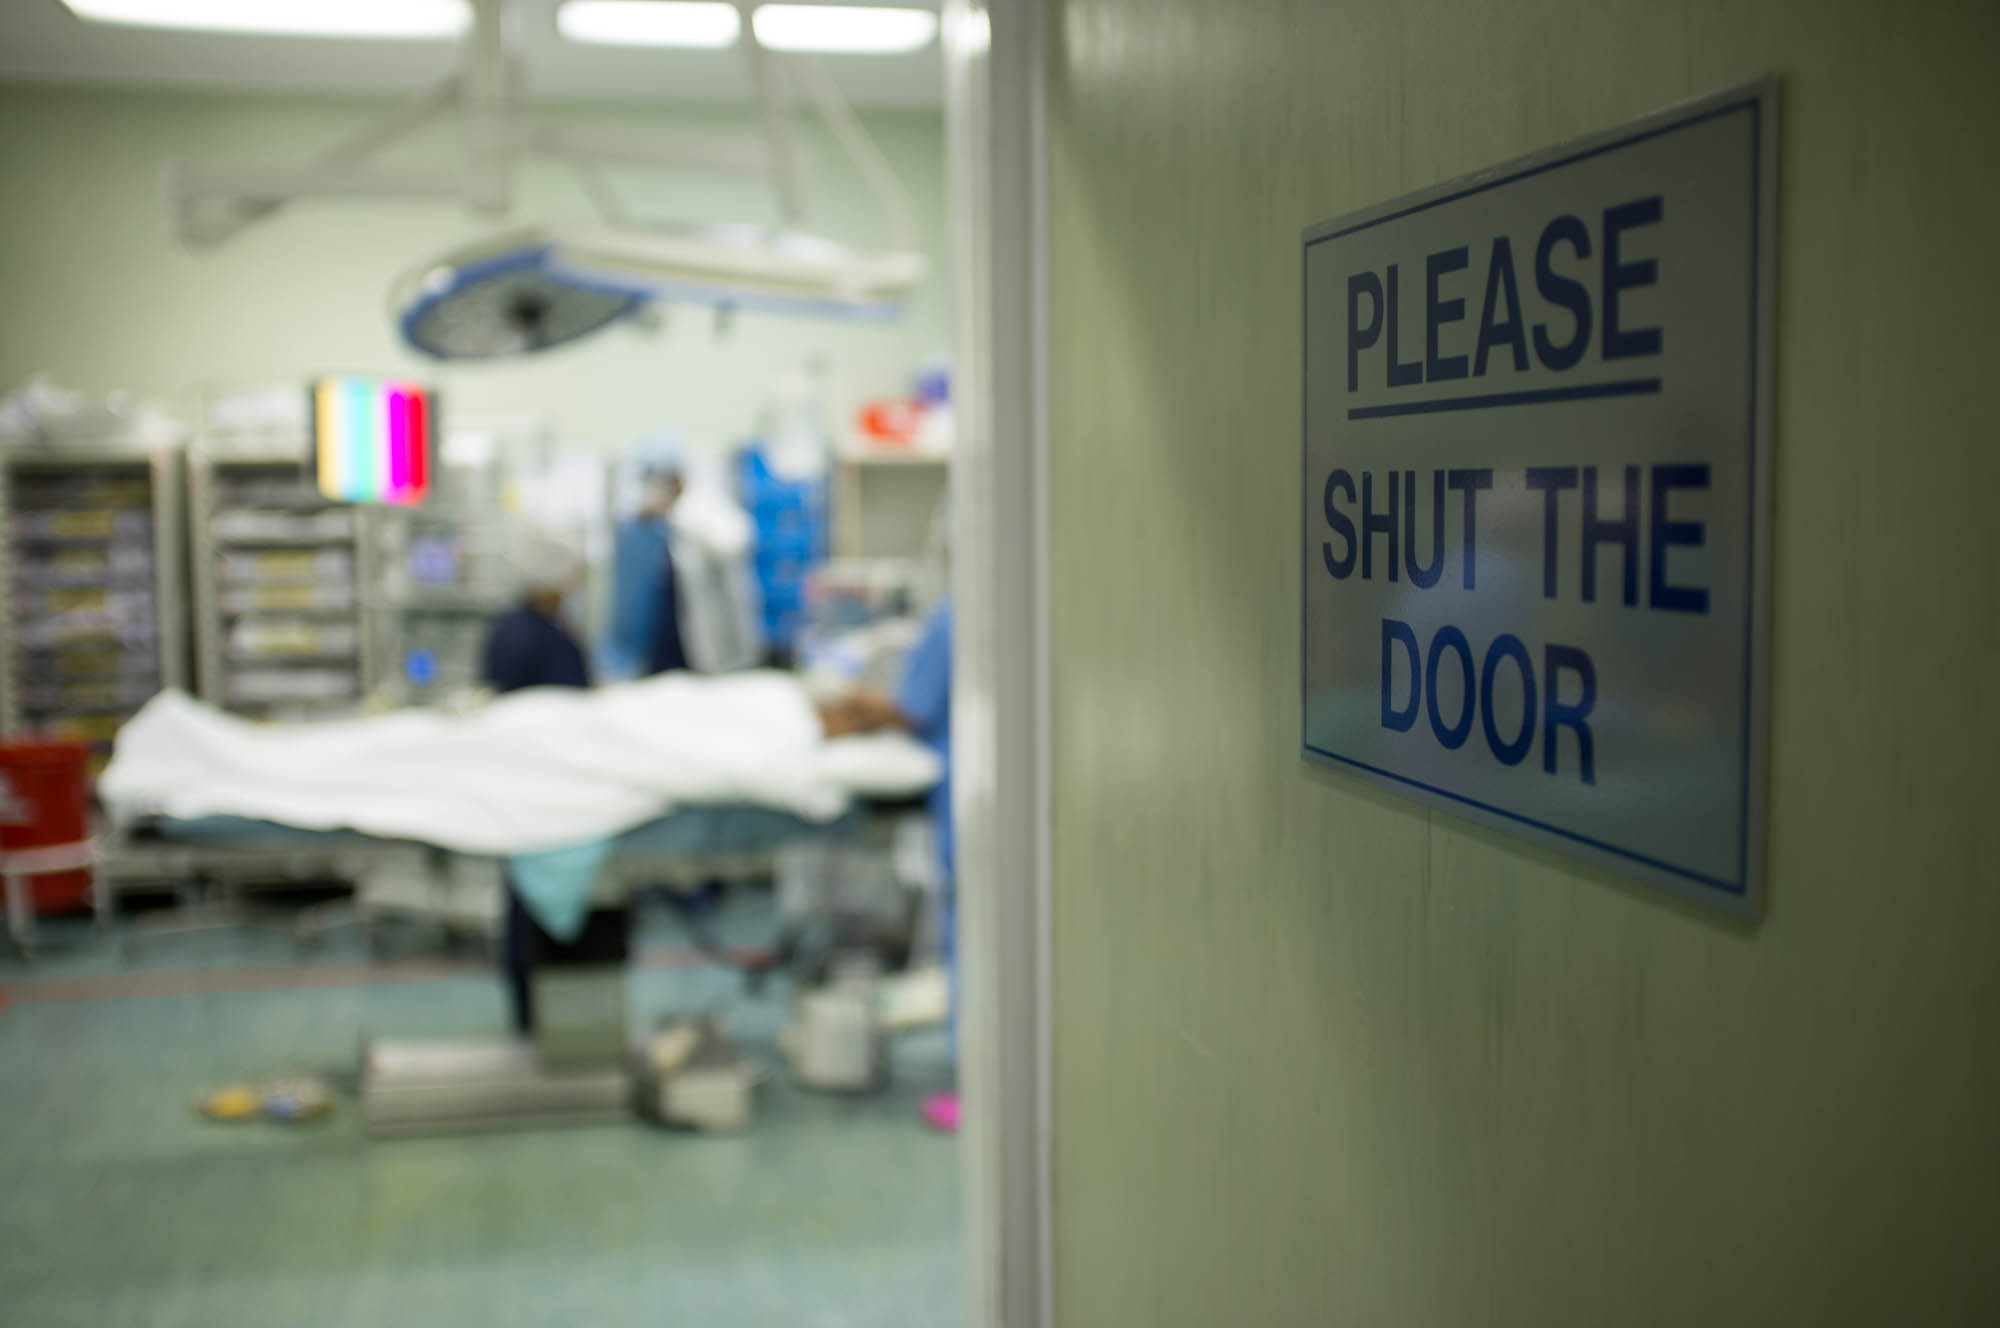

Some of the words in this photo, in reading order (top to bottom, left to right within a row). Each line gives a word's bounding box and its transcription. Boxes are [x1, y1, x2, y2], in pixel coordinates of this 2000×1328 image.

[1347, 195, 1663, 392] PLEASE
[1323, 469, 1492, 591] SHUT
[1526, 465, 1709, 614] THE
[1381, 619, 1596, 785] DOOR
